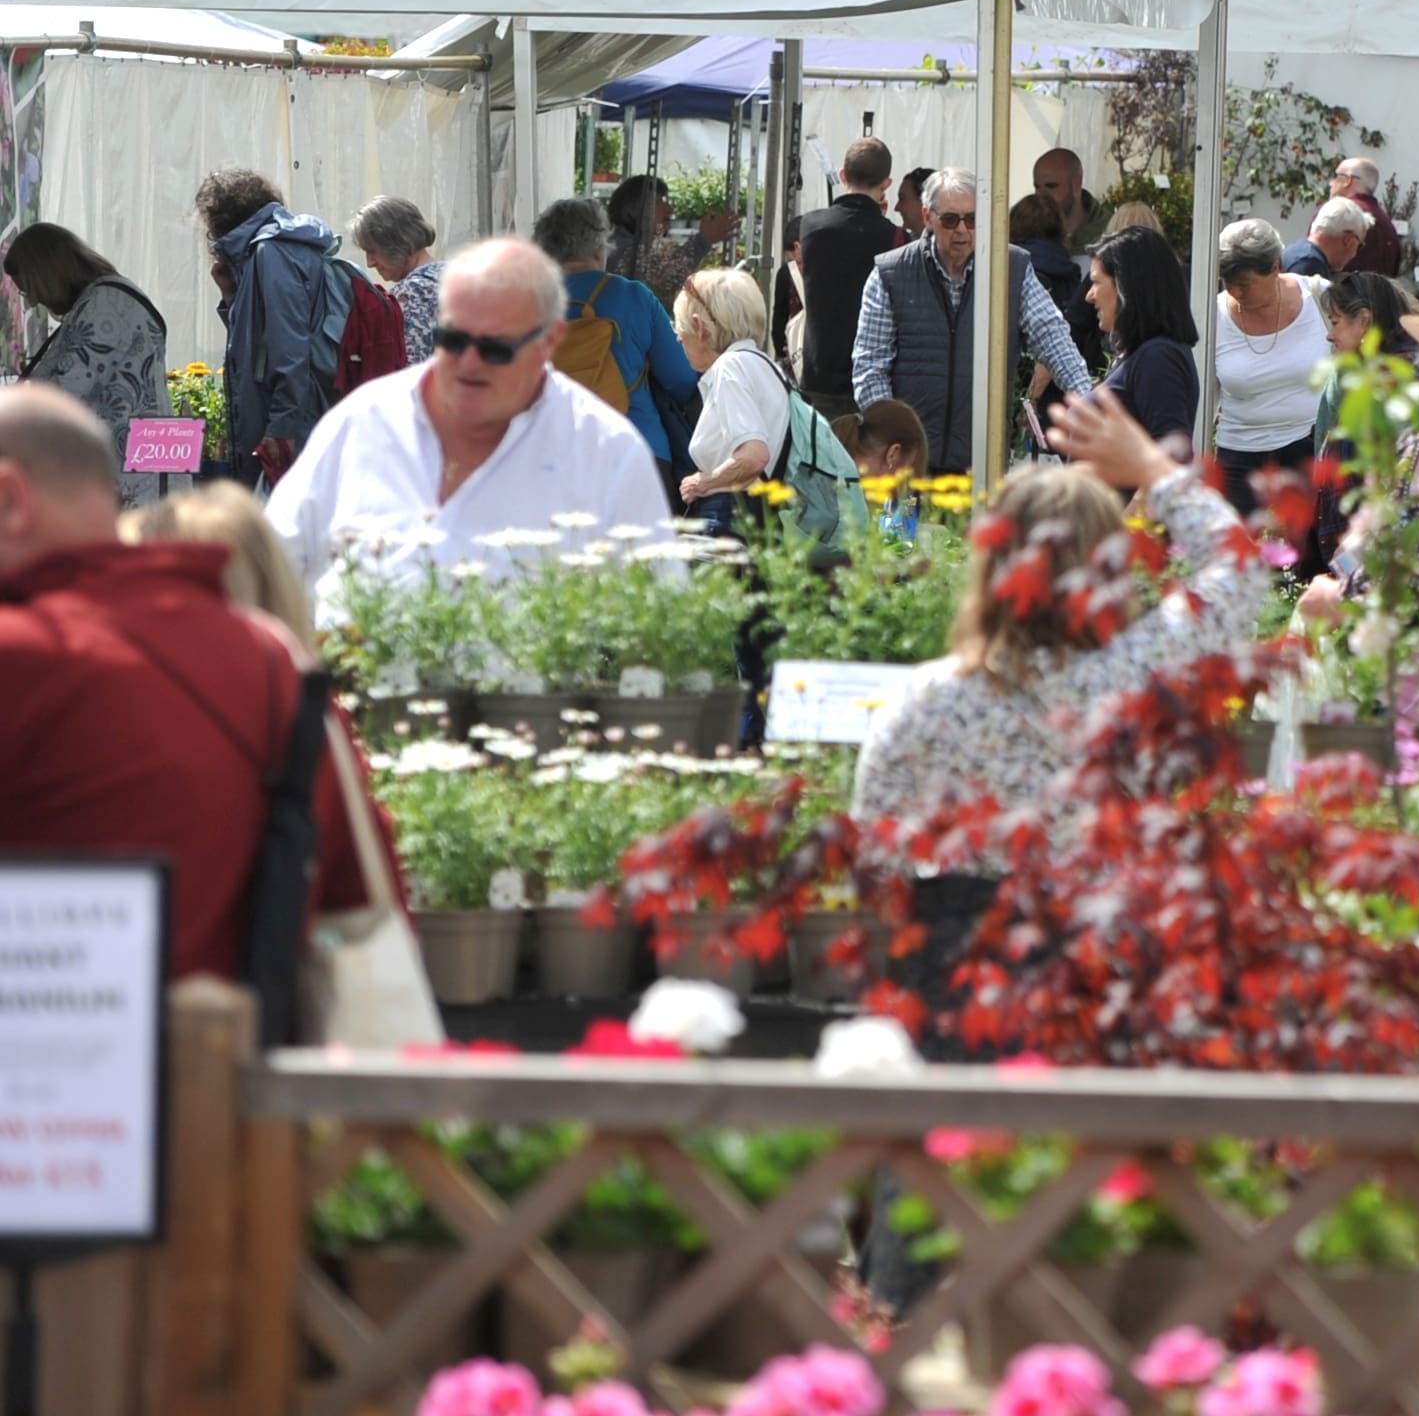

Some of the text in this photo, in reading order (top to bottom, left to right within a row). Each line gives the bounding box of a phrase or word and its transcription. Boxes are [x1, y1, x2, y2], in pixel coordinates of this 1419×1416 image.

[137, 427, 156, 439] Any
[167, 426, 195, 436] Plants
[130, 443, 192, 464] £20.00
